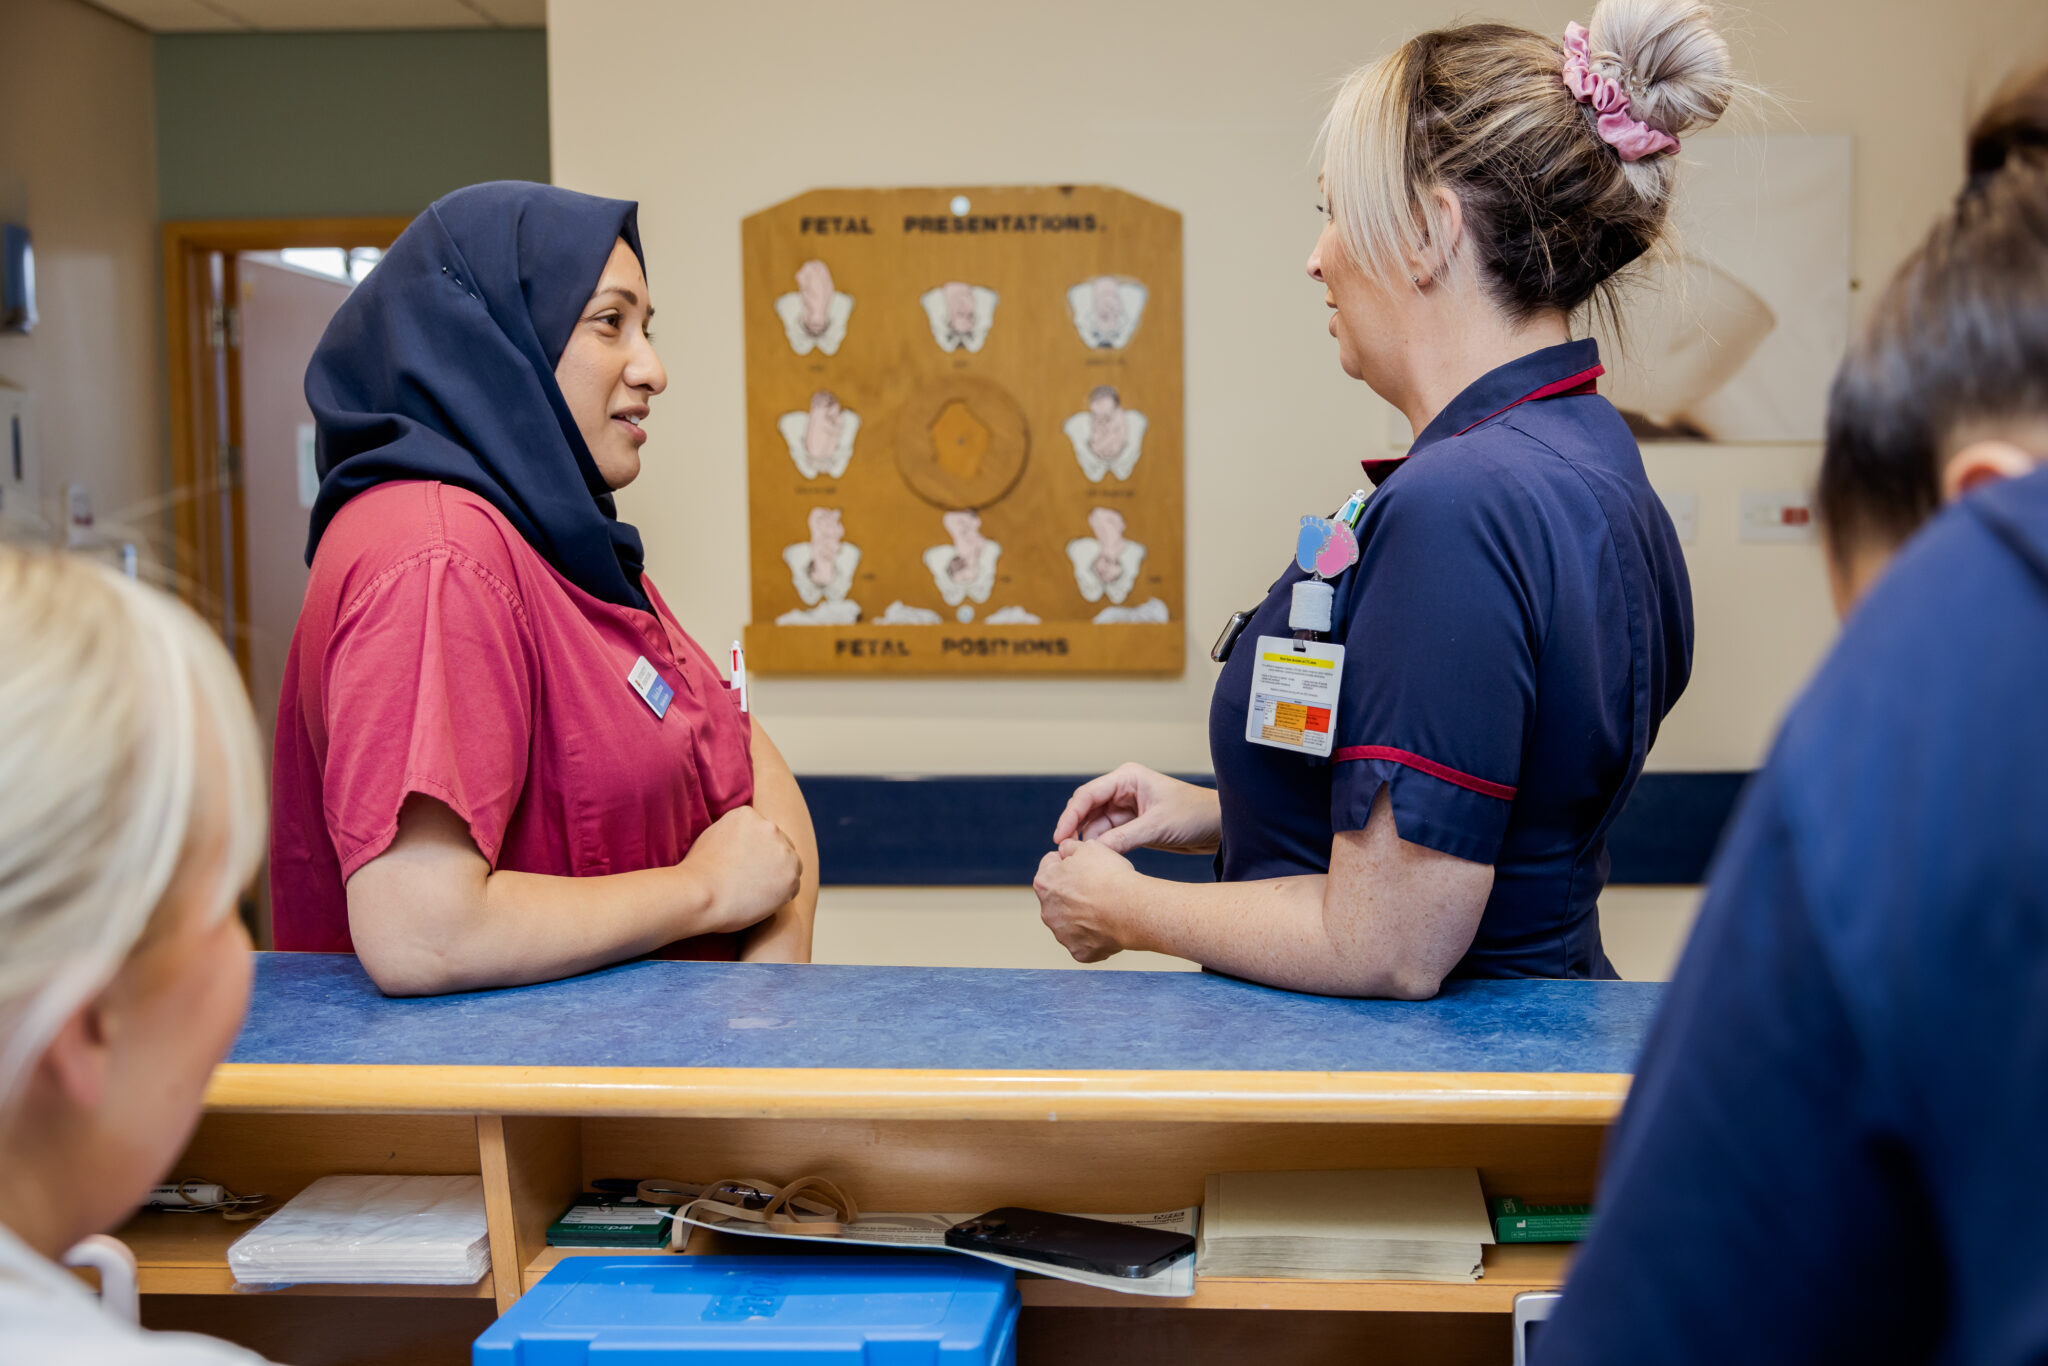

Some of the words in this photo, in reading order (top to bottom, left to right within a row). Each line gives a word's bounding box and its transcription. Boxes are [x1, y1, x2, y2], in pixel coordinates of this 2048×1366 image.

[801, 216, 873, 234] FETAL
[835, 638, 911, 657] FETAL
[941, 637, 1070, 657] POSITIONS
